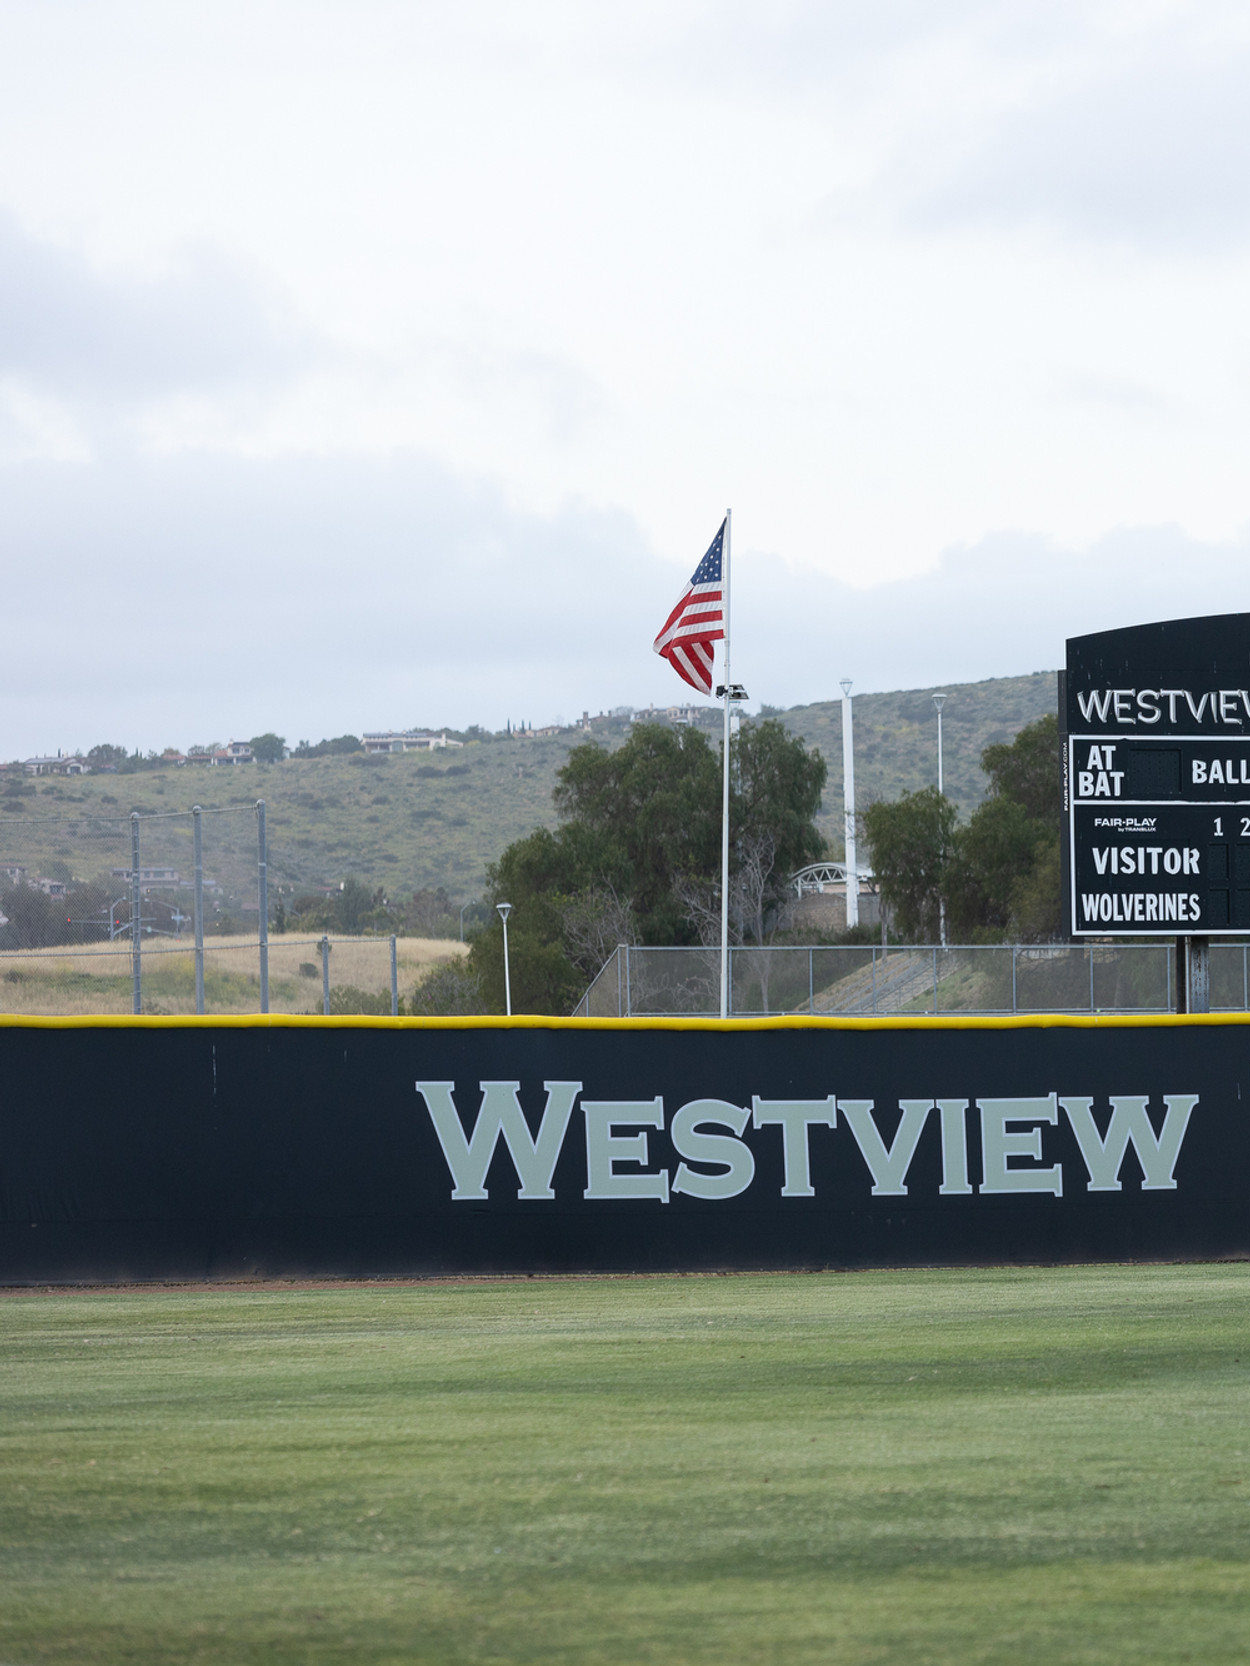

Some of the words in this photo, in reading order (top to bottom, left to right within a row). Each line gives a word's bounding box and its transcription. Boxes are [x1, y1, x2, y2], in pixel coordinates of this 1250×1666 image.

[1086, 745, 1117, 771] AT
[1078, 771, 1125, 797] BAT
[1094, 817, 1157, 827] FAIR-PLAY
[1213, 817, 1224, 837] 1
[1092, 846, 1200, 875] VISITOR
[1081, 892, 1201, 922] WOLVERINES
[414, 1080, 1201, 1204] WESTVIEW
